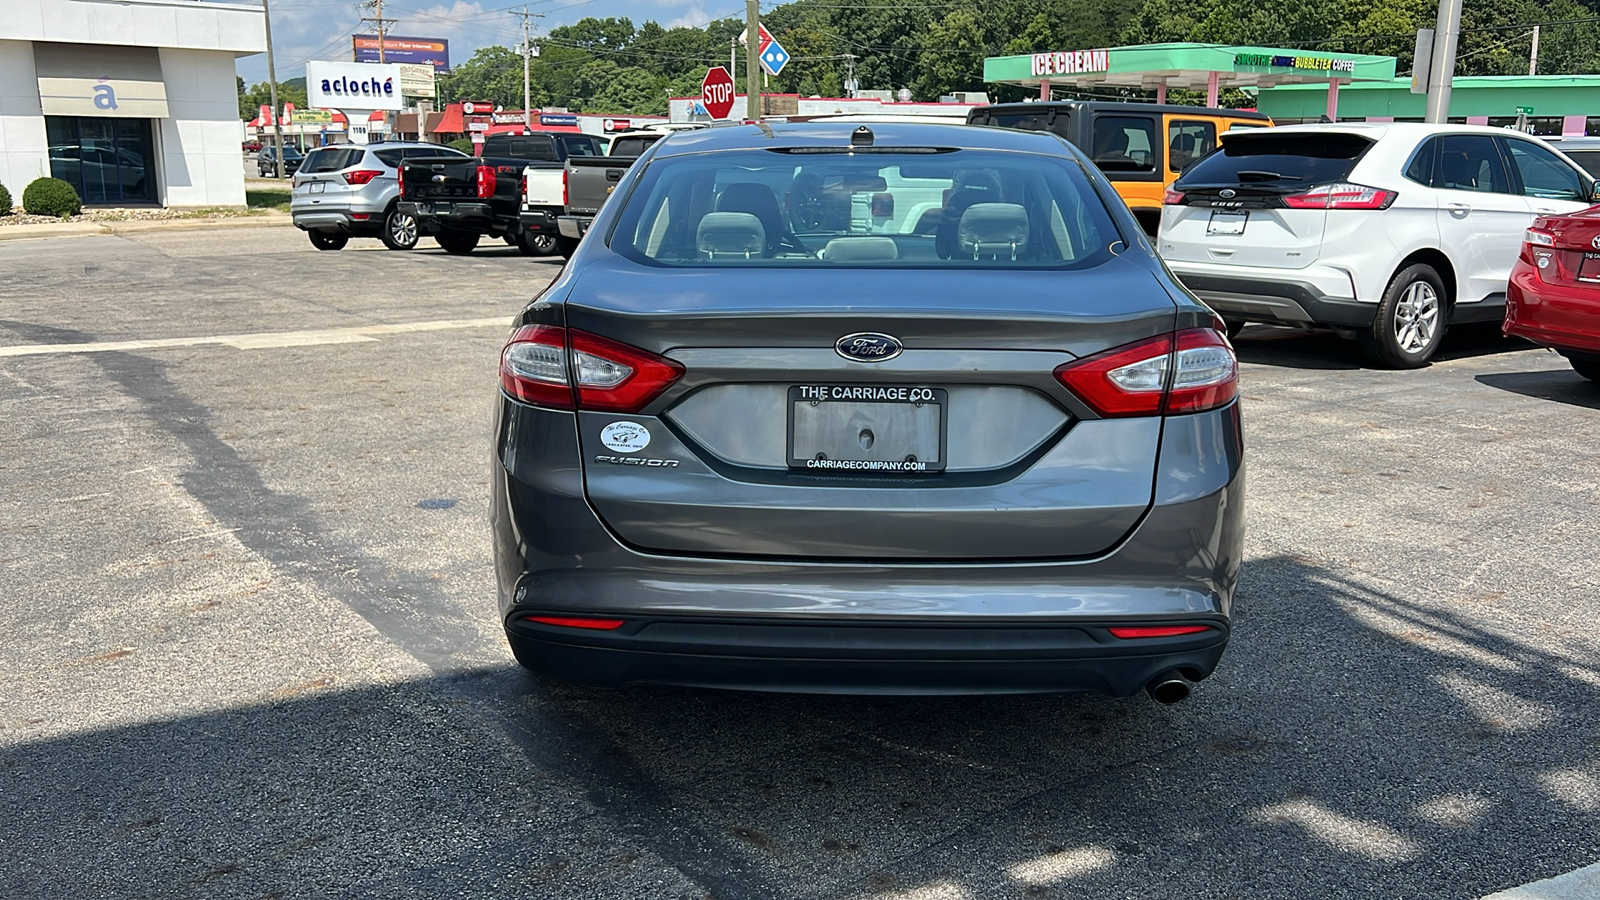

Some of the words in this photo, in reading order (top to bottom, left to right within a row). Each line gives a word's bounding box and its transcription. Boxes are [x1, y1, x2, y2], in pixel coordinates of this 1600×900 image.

[1031, 53, 1054, 76] ICE
[1055, 50, 1108, 74] CREAM
[1332, 59, 1355, 71] COFFEE
[321, 76, 393, 94] acloché
[704, 82, 732, 105] STOP
[849, 338, 888, 355] Ford
[800, 386, 828, 398] THE
[832, 387, 907, 400] CARRIAGE
[911, 388, 935, 400] CO.
[594, 455, 680, 468] FUSION
[807, 460, 926, 471] CARRIAGECOMPANY.COM
